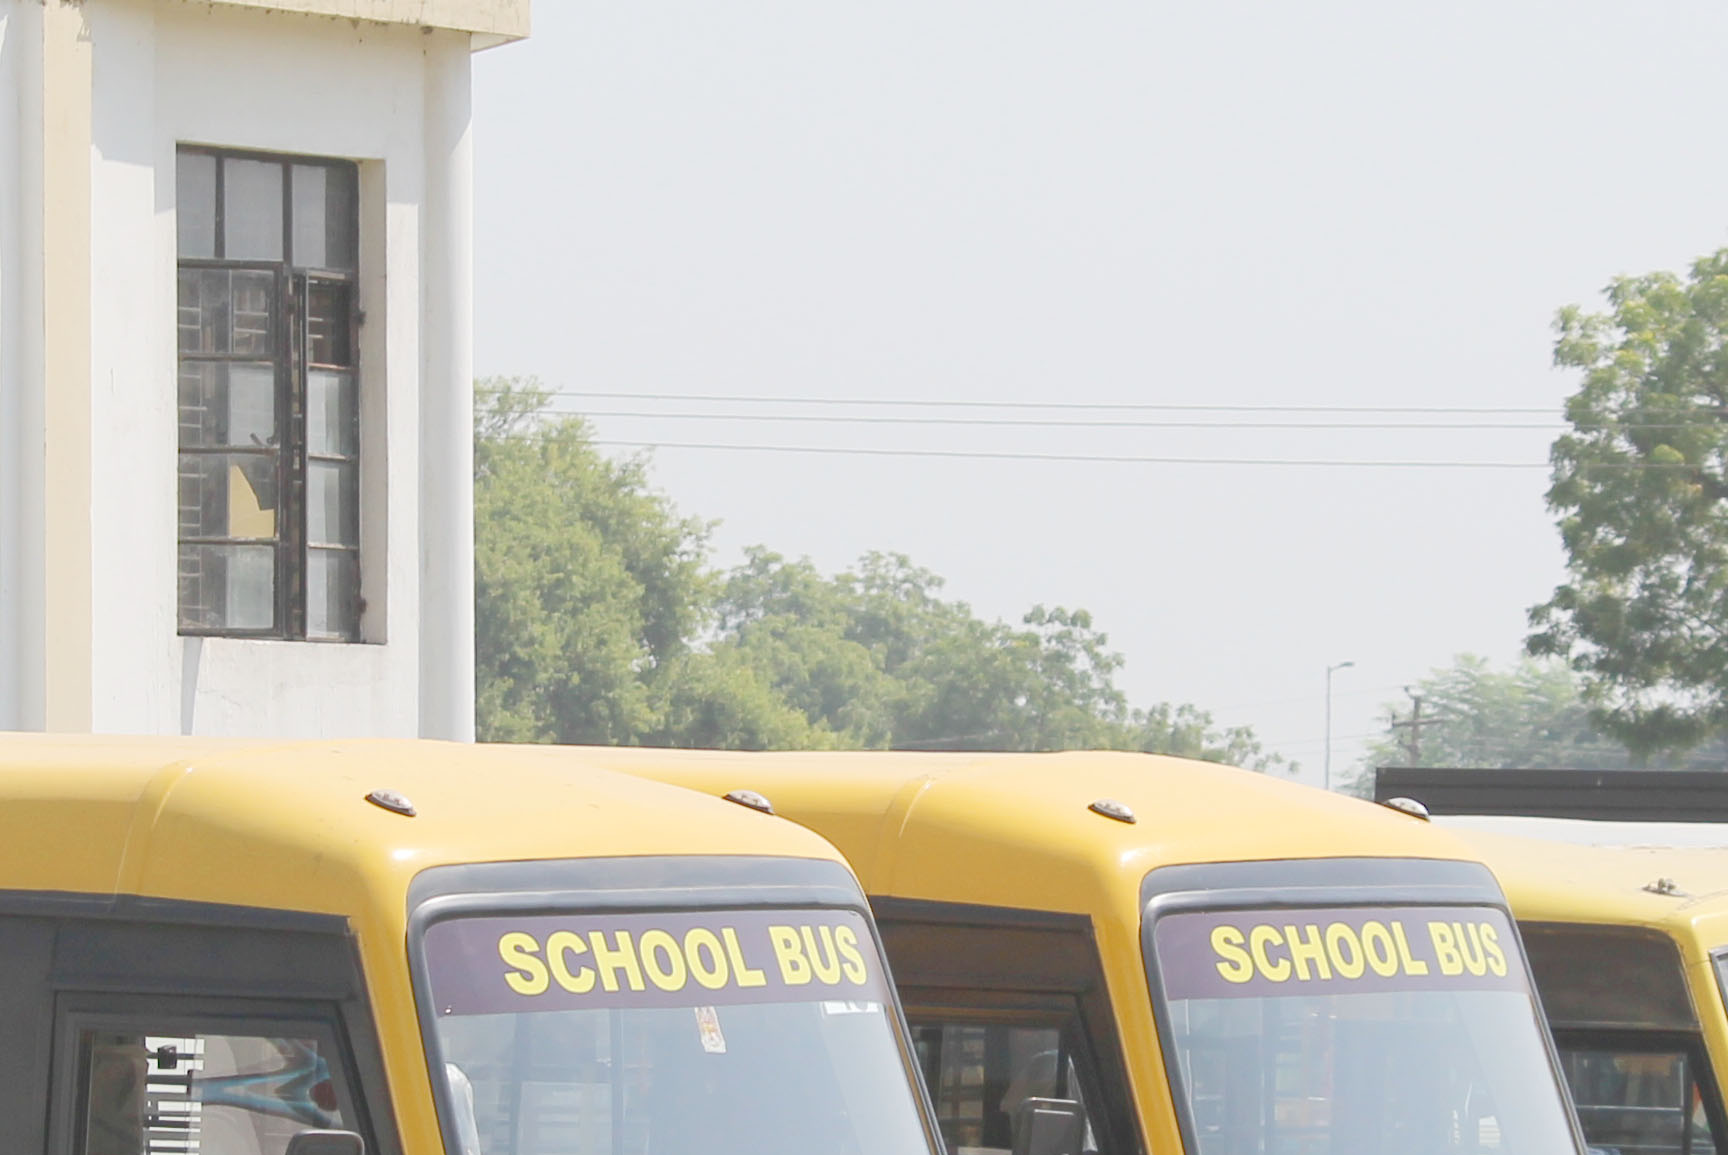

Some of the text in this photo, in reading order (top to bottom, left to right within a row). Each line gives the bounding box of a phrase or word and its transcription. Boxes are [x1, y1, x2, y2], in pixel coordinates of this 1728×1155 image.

[497, 924, 869, 996] SCHOOL BUS
[1209, 920, 1509, 985] SCHOOL BUS
